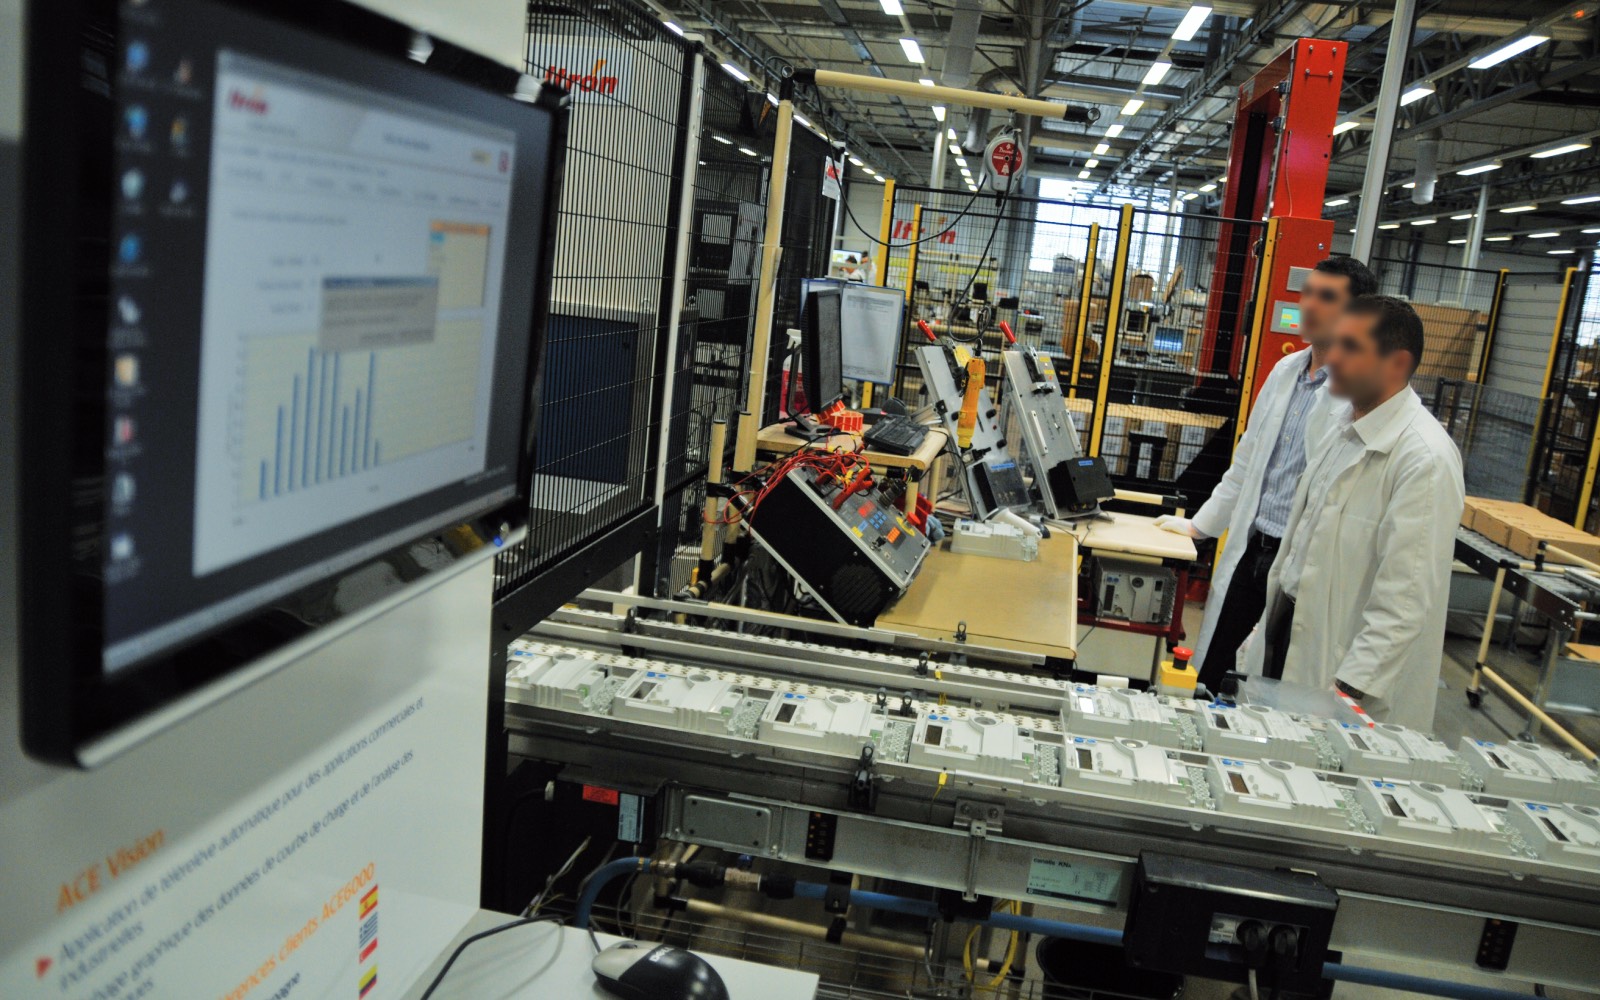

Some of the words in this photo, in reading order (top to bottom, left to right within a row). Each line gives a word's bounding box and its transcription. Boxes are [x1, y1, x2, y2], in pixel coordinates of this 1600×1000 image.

[893, 215, 957, 245] Itn
[57, 863, 102, 915] ACE
[321, 862, 374, 922] ACE6000
